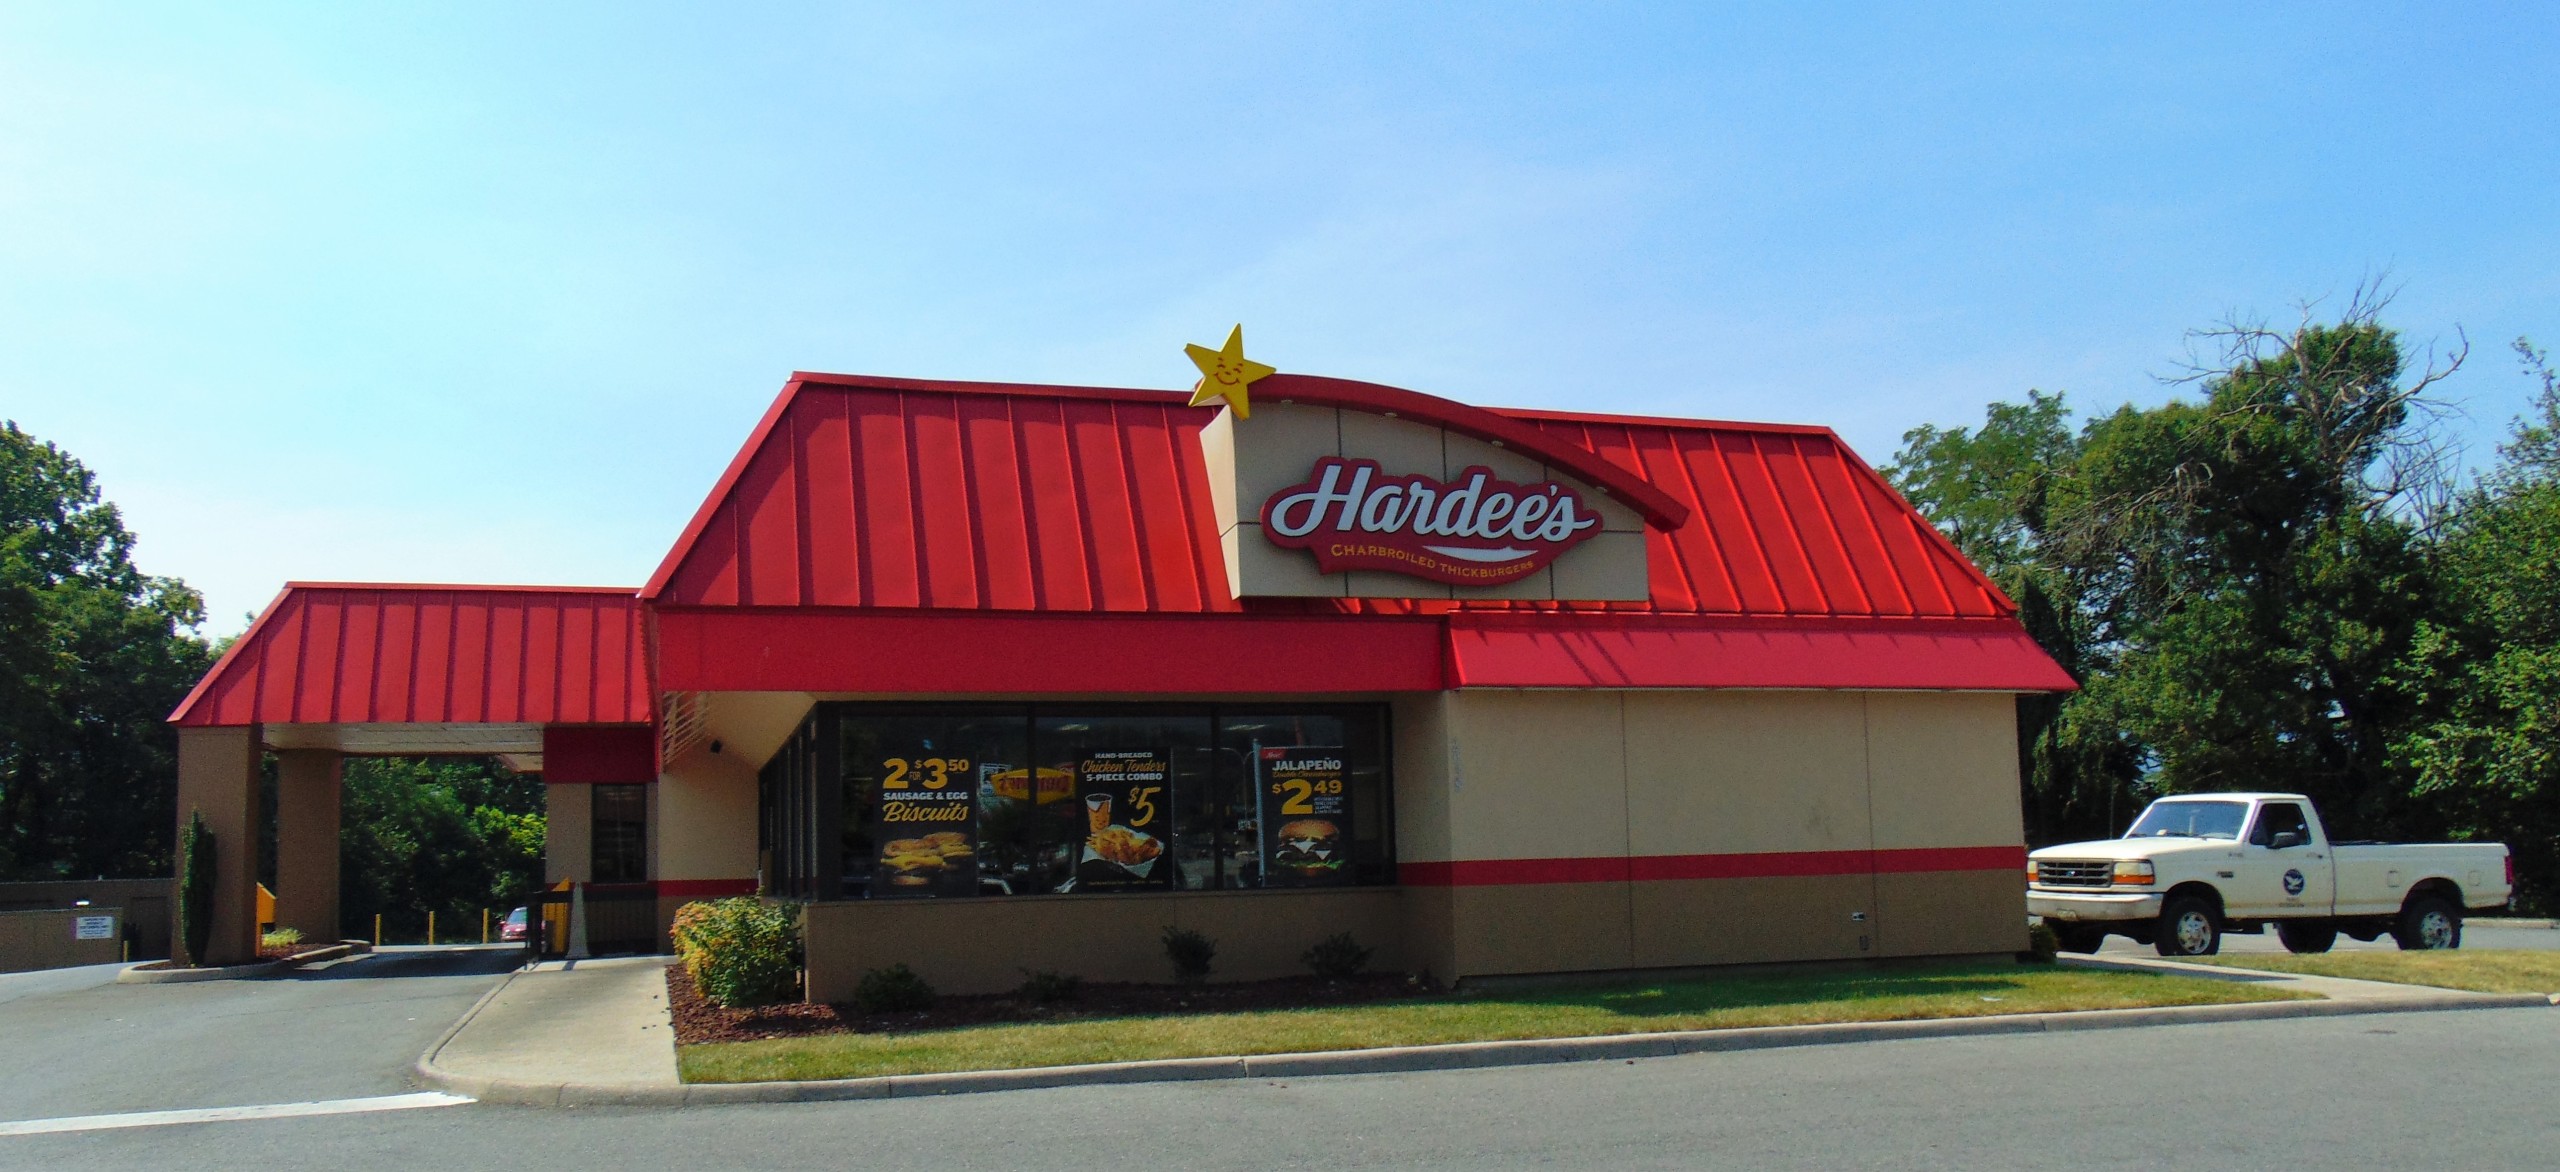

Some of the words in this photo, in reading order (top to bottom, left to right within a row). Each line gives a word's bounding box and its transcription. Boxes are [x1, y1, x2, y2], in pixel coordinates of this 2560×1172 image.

[1270, 465, 1595, 542] Hardee's
[1331, 543, 1437, 569] CHARBROILED
[1440, 560, 1535, 578] THICKBURGERS
[882, 758, 910, 789] 2
[1081, 760, 1124, 773] Chicken
[1124, 759, 1166, 772] Tenders
[1272, 757, 1342, 771] JALAPEÑO
[1086, 773, 1125, 782] 5-PIECE
[1127, 772, 1163, 781] COMBO
[883, 792, 934, 801] SAUSAGE
[935, 792, 944, 800] &
[946, 791, 969, 801] EGG
[1128, 785, 1162, 827] $5
[882, 801, 970, 822] Biscuits
